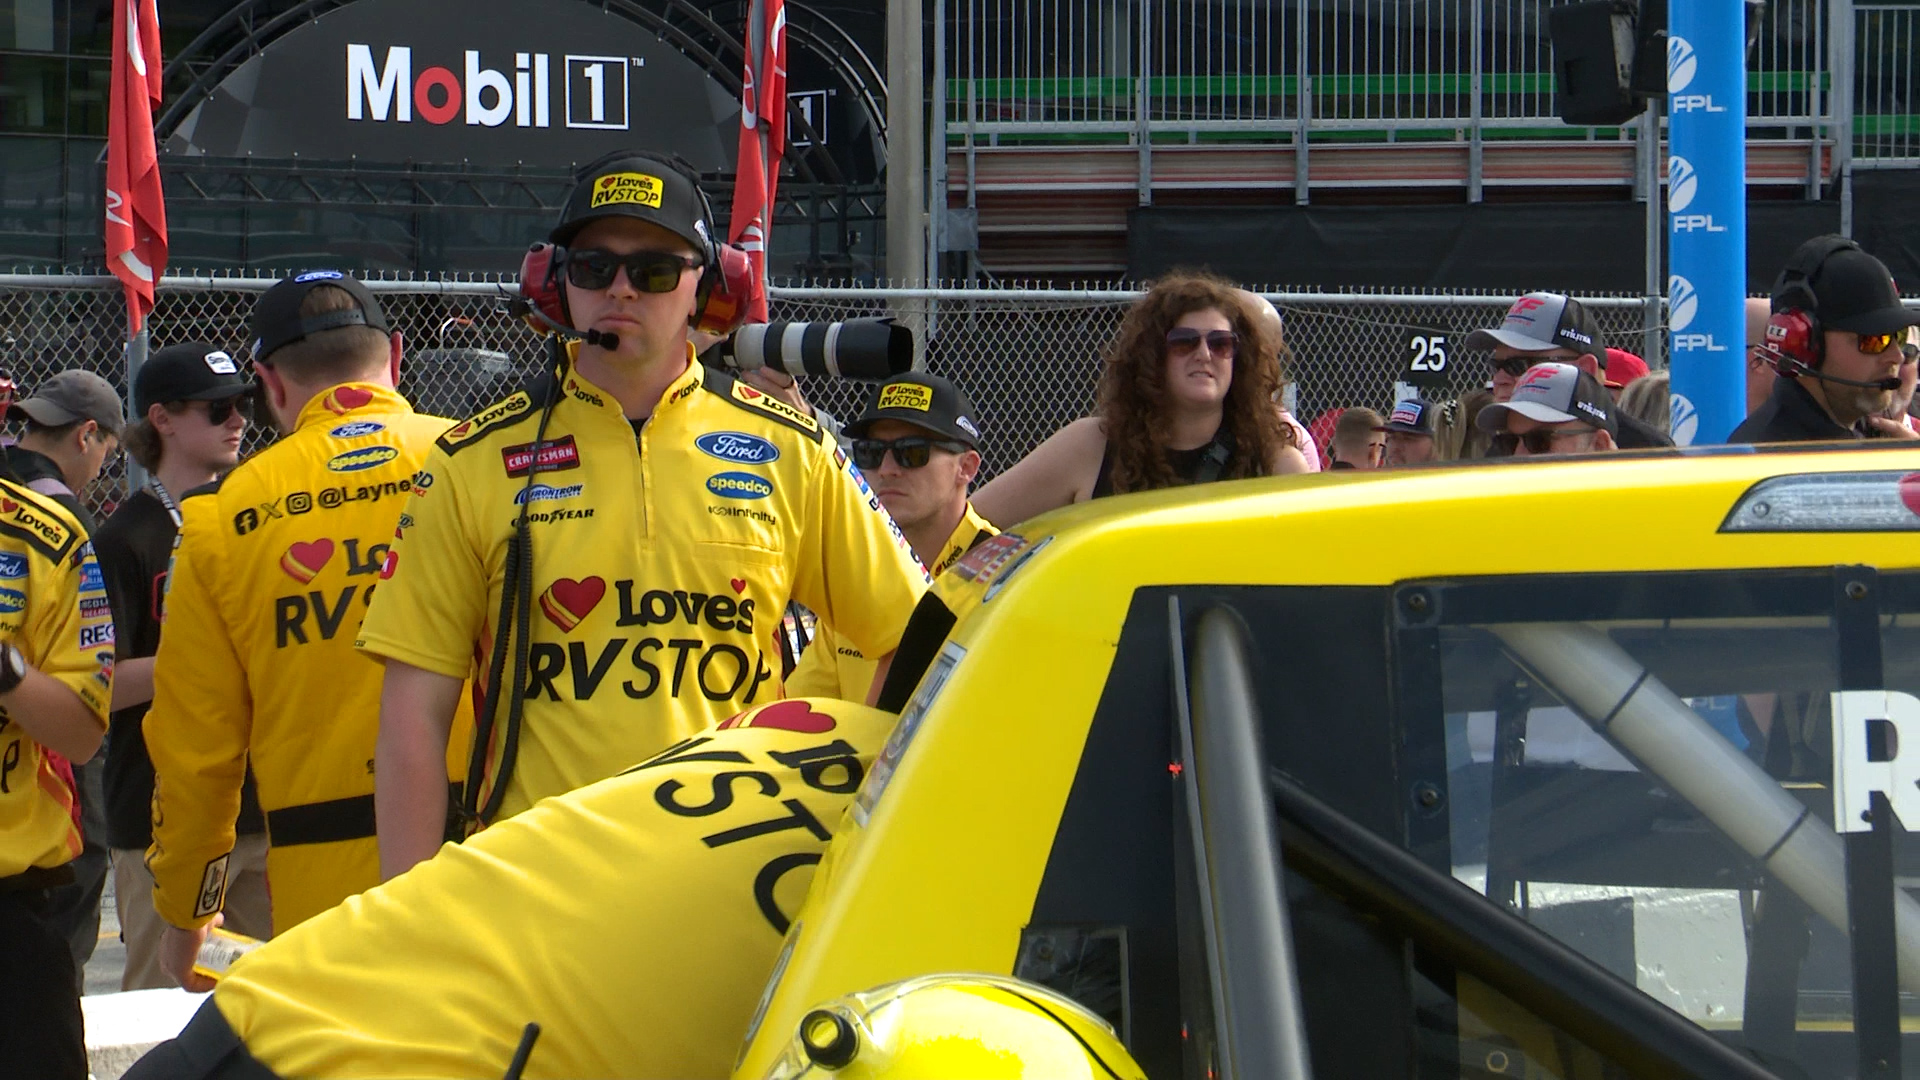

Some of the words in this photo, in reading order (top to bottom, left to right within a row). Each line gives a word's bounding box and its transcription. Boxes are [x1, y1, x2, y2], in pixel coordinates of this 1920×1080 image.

[347, 44, 550, 128] Mobil
[1673, 94, 1724, 113] FPL
[1673, 215, 1724, 232] FPL
[1674, 333, 1724, 351] FPL
[1410, 336, 1446, 371] 25
[712, 434, 764, 461] Ford
[318, 473, 417, 510] @Layne
[709, 476, 770, 495] speedco
[837, 647, 863, 659] GOO
